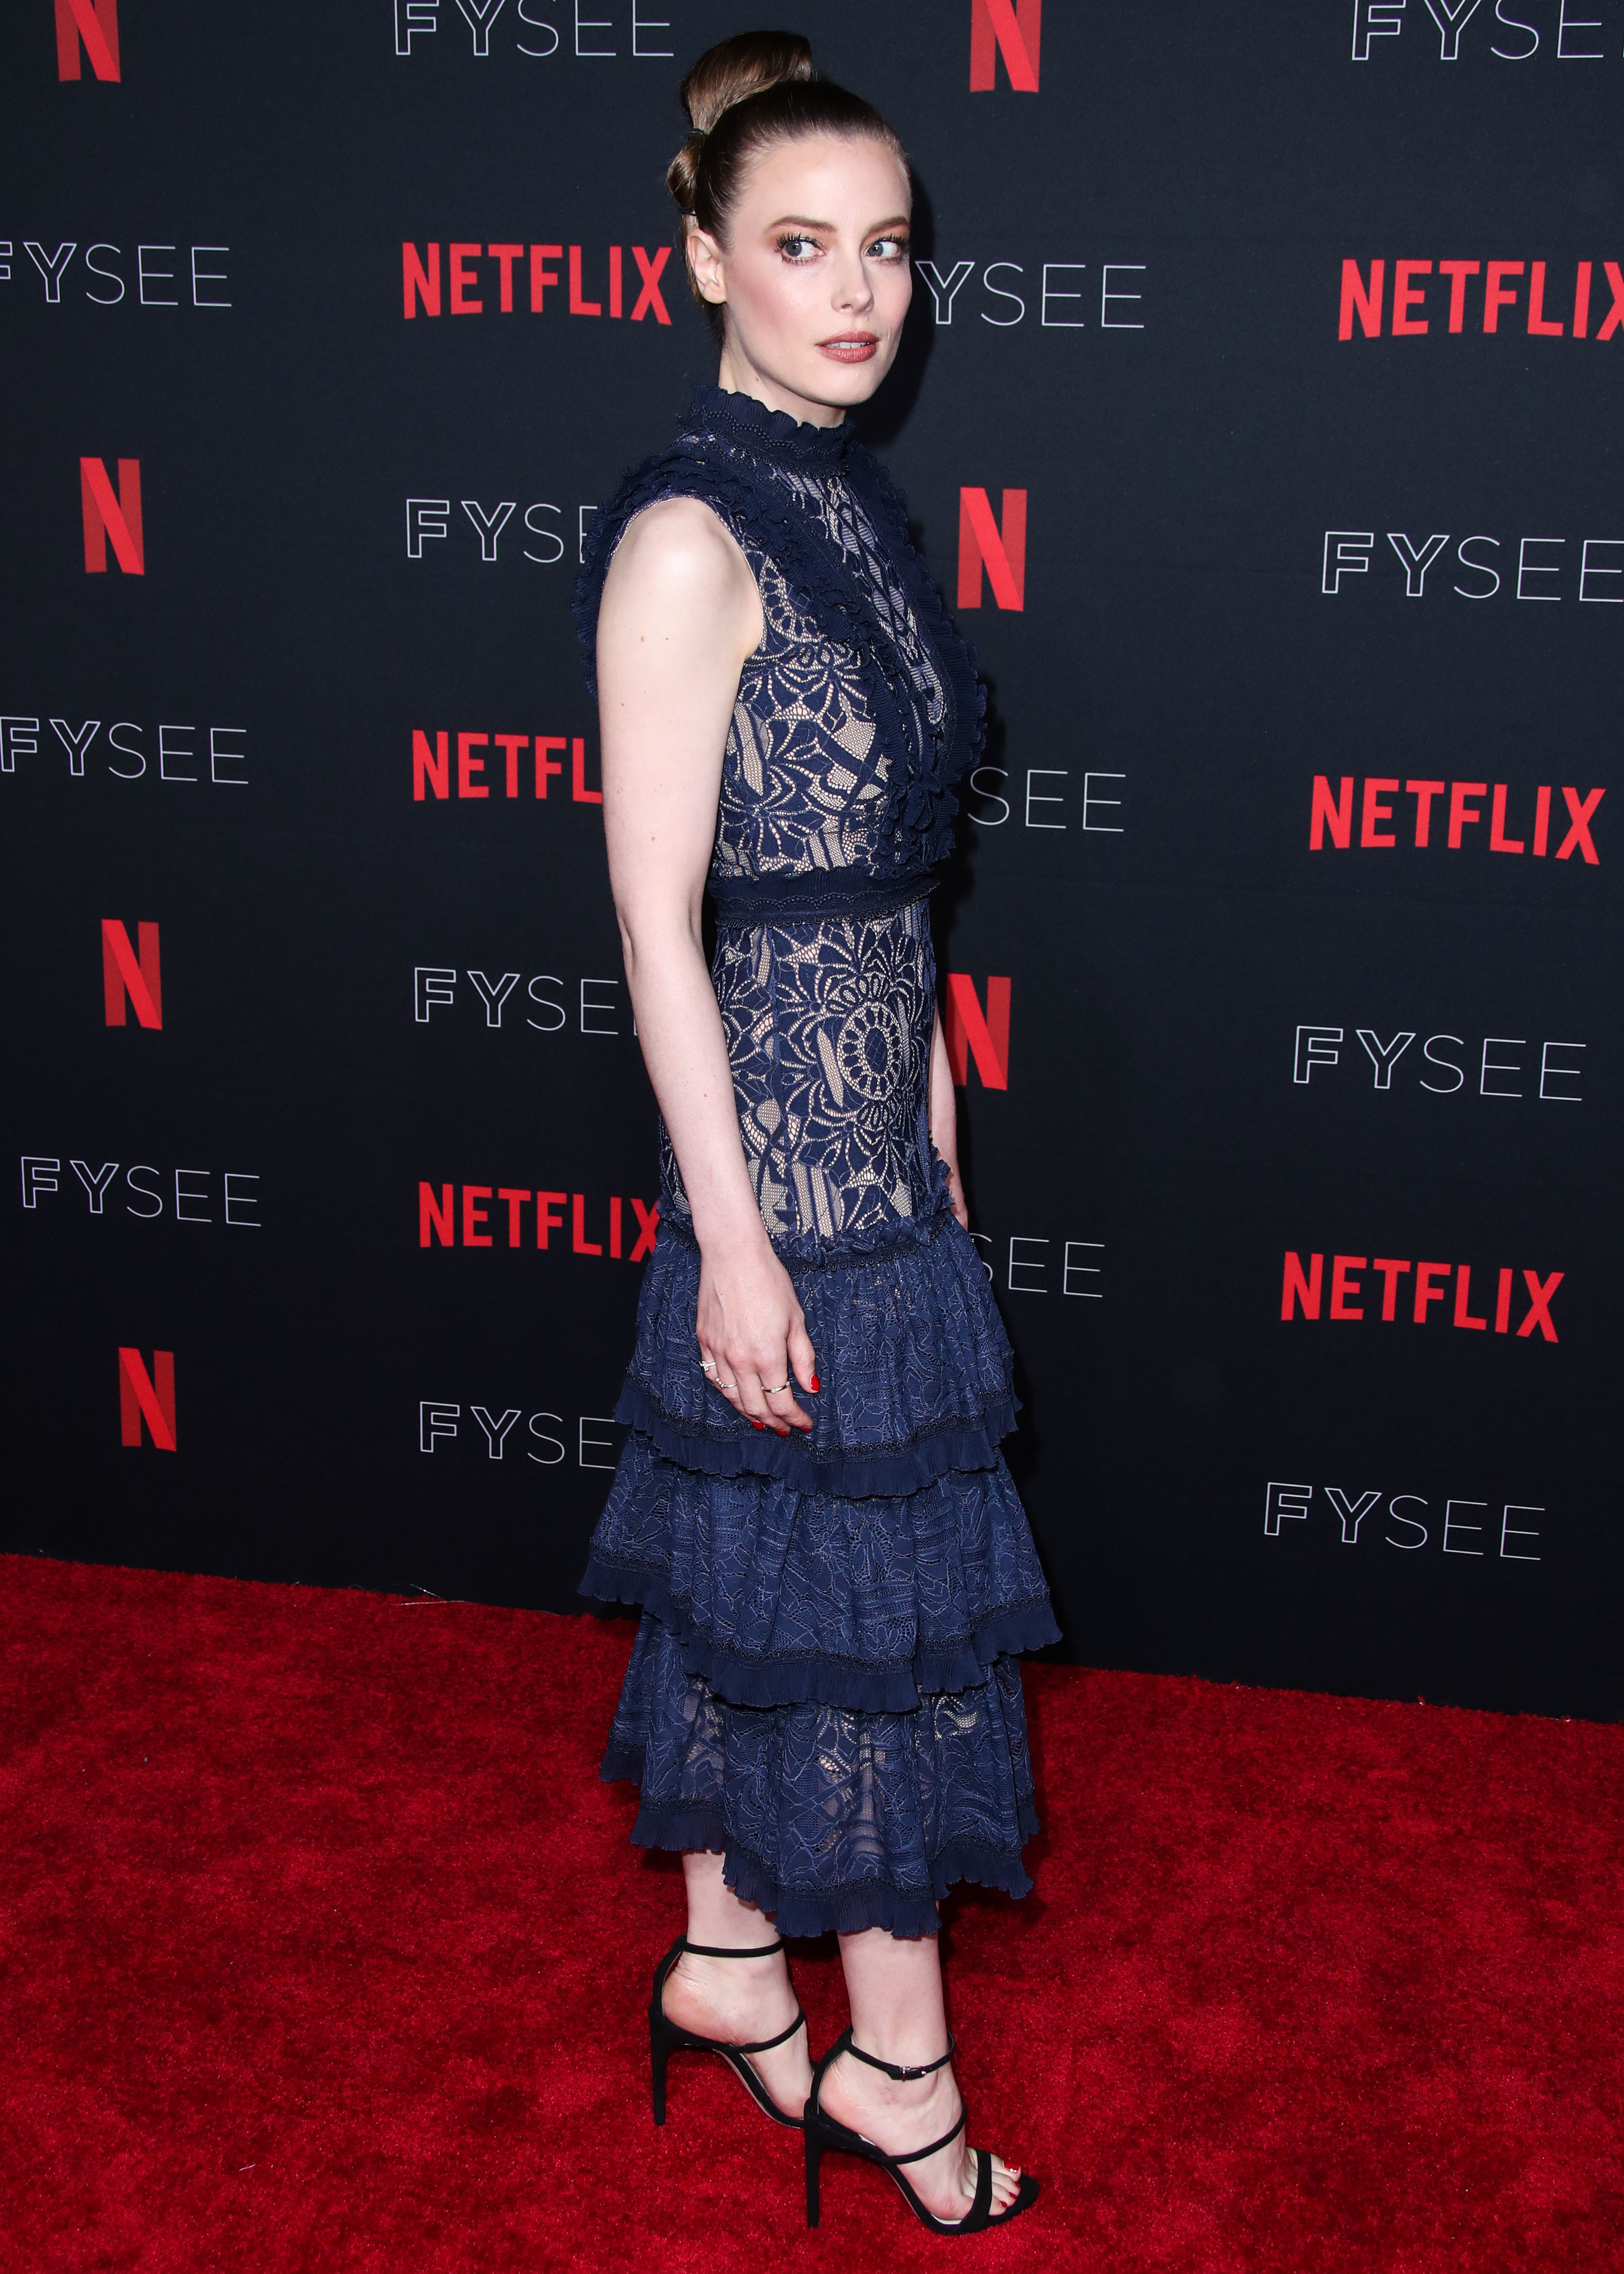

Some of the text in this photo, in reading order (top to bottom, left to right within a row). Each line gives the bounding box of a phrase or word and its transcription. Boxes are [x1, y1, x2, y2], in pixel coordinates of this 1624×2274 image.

[394, 0, 674, 57] FYSEE
[1352, 0, 1624, 61] FYSE
[402, 242, 672, 326] NETFLIX
[915, 260, 1146, 328] YSEE
[80, 457, 145, 576] N
[957, 486, 1028, 612] N
[1321, 531, 1624, 603] FYSEE
[0, 716, 249, 784] FYSEE
[412, 729, 603, 804] NETFL
[968, 767, 1126, 832] SEE
[1309, 775, 1606, 866] NETFLIX
[101, 918, 163, 1031] N
[414, 967, 639, 1036] FYSE
[1292, 1025, 1587, 1102] FYSEE
[21, 1156, 262, 1227] FYSEE
[419, 1181, 661, 1263] NETFLIX
[1281, 1251, 1565, 1343] NETFLIX
[118, 1347, 177, 1452] N
[419, 1401, 616, 1470] FYSE
[1264, 1482, 1546, 1561] FYSEE
